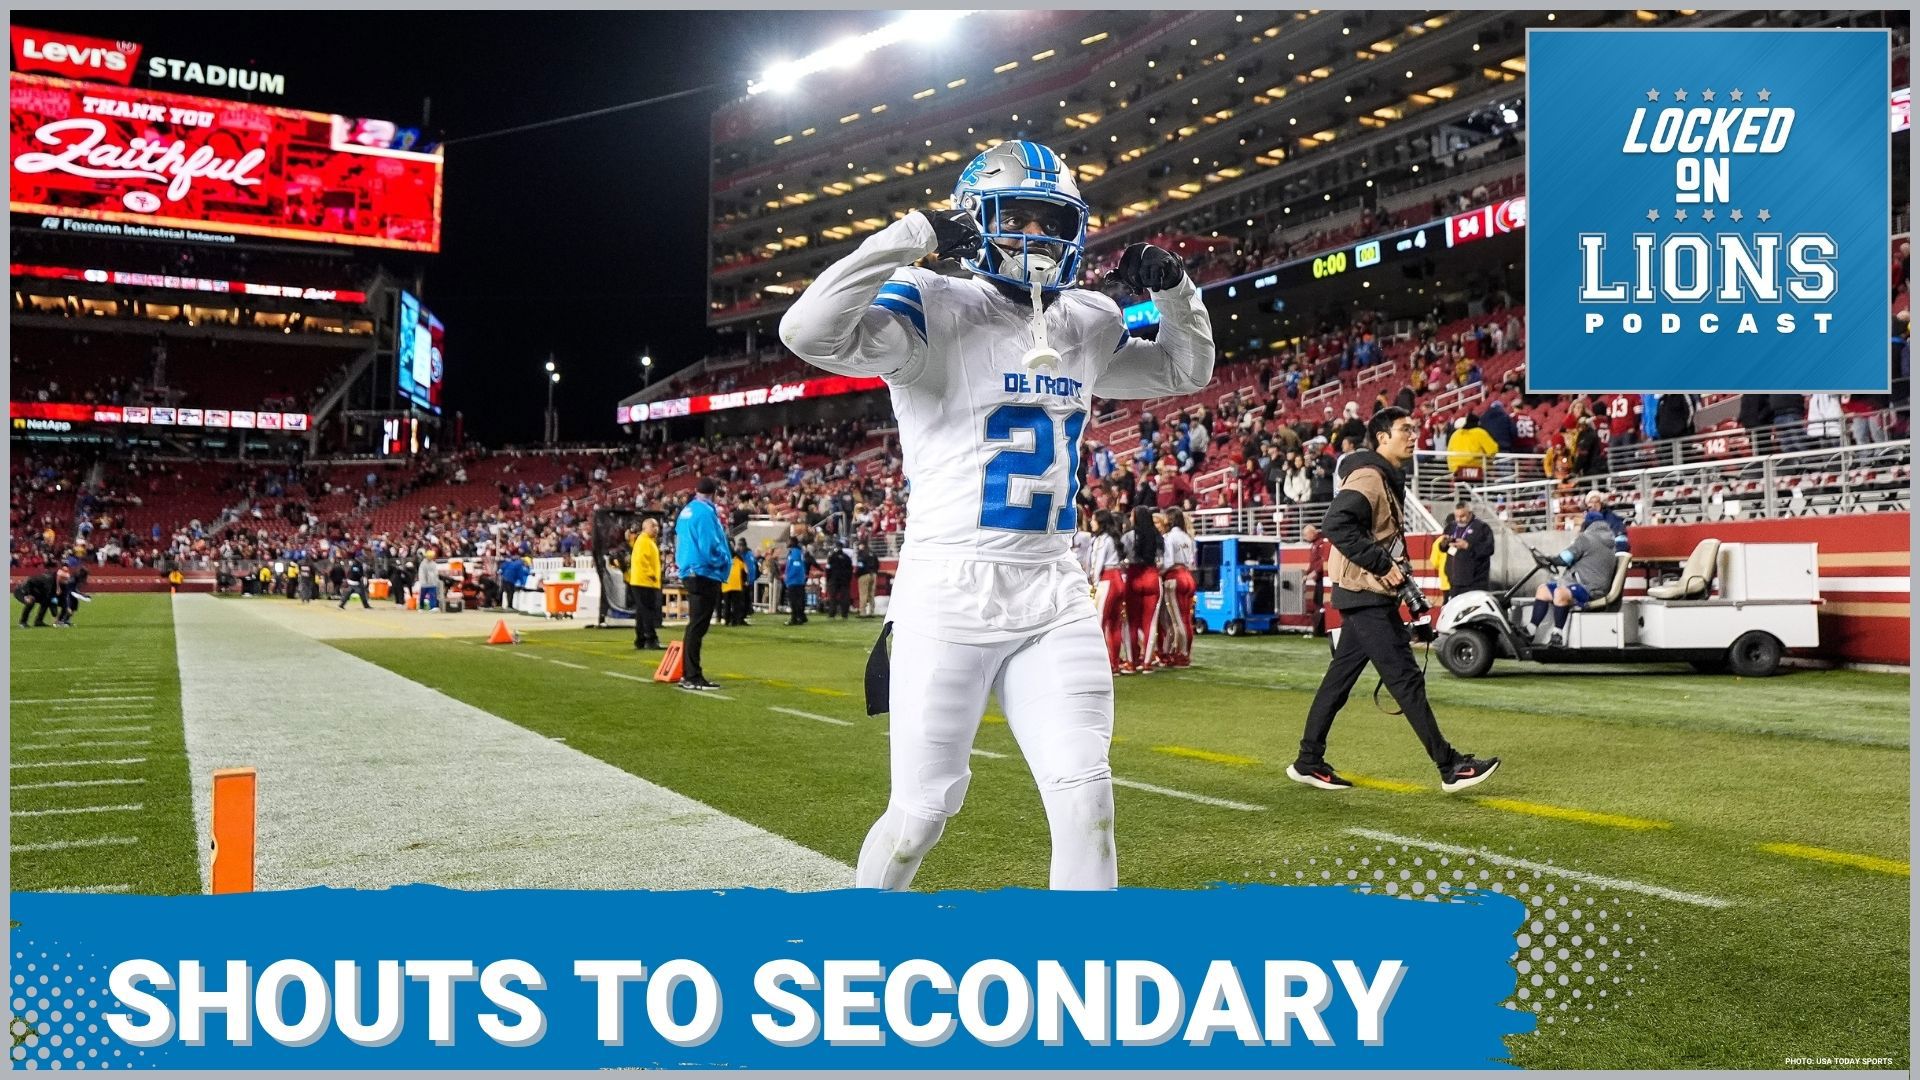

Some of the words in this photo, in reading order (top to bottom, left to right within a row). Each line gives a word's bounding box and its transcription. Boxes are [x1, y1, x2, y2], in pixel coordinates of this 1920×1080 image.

[149, 56, 285, 95] STADIUM
[82, 96, 167, 122] THANK
[168, 106, 216, 128] YOU
[14, 118, 266, 201] Faithful
[63, 218, 122, 235] Foxconn
[123, 224, 185, 239] Industrial
[186, 230, 236, 243] Internet
[1414, 230, 1426, 248] 4
[1458, 215, 1480, 238] 34
[1312, 252, 1347, 279] 0:00
[1611, 398, 1629, 418] 13
[27, 419, 71, 432] NetApp
[977, 402, 1087, 535] 21
[559, 587, 575, 605] G
